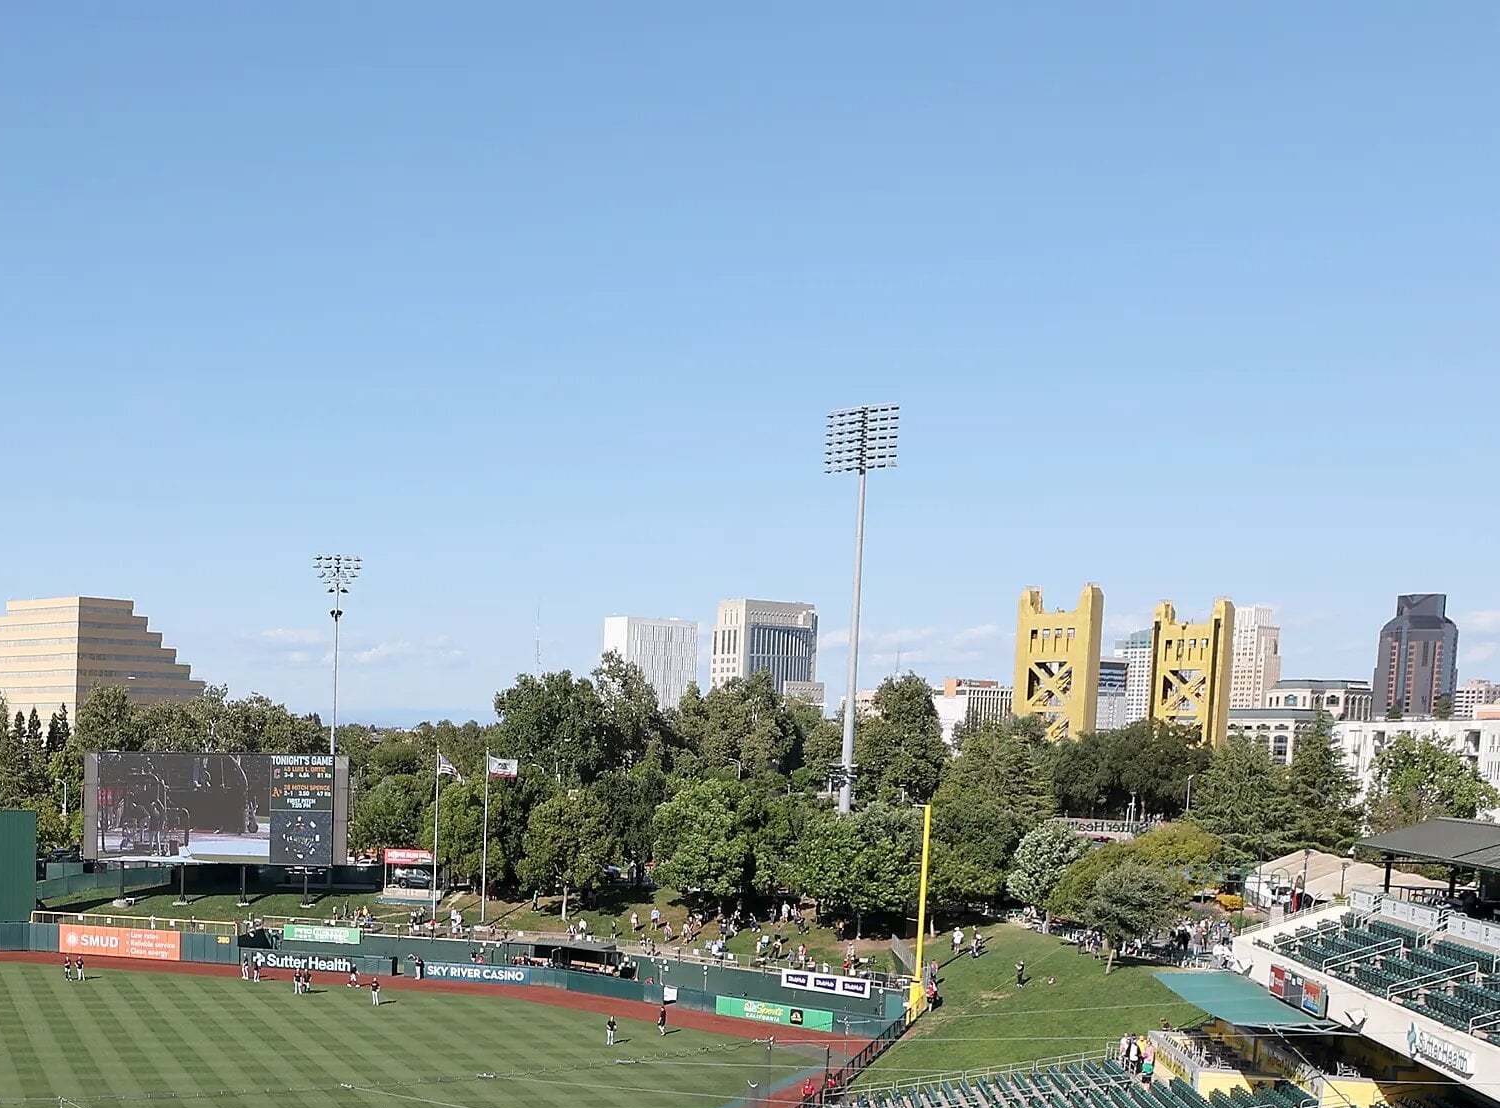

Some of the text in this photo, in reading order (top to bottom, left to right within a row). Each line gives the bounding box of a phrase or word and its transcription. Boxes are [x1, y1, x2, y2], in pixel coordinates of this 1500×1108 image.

[271, 756, 333, 765] TONIGHT'S GAME
[80, 935, 119, 948] SMUD
[266, 953, 351, 972] Sutter Health
[427, 965, 524, 981] SKY RIVER CASINO
[756, 1003, 784, 1016] Sports
[745, 1012, 780, 1022] CALIFORNIA
[1441, 1041, 1468, 1072] Health
